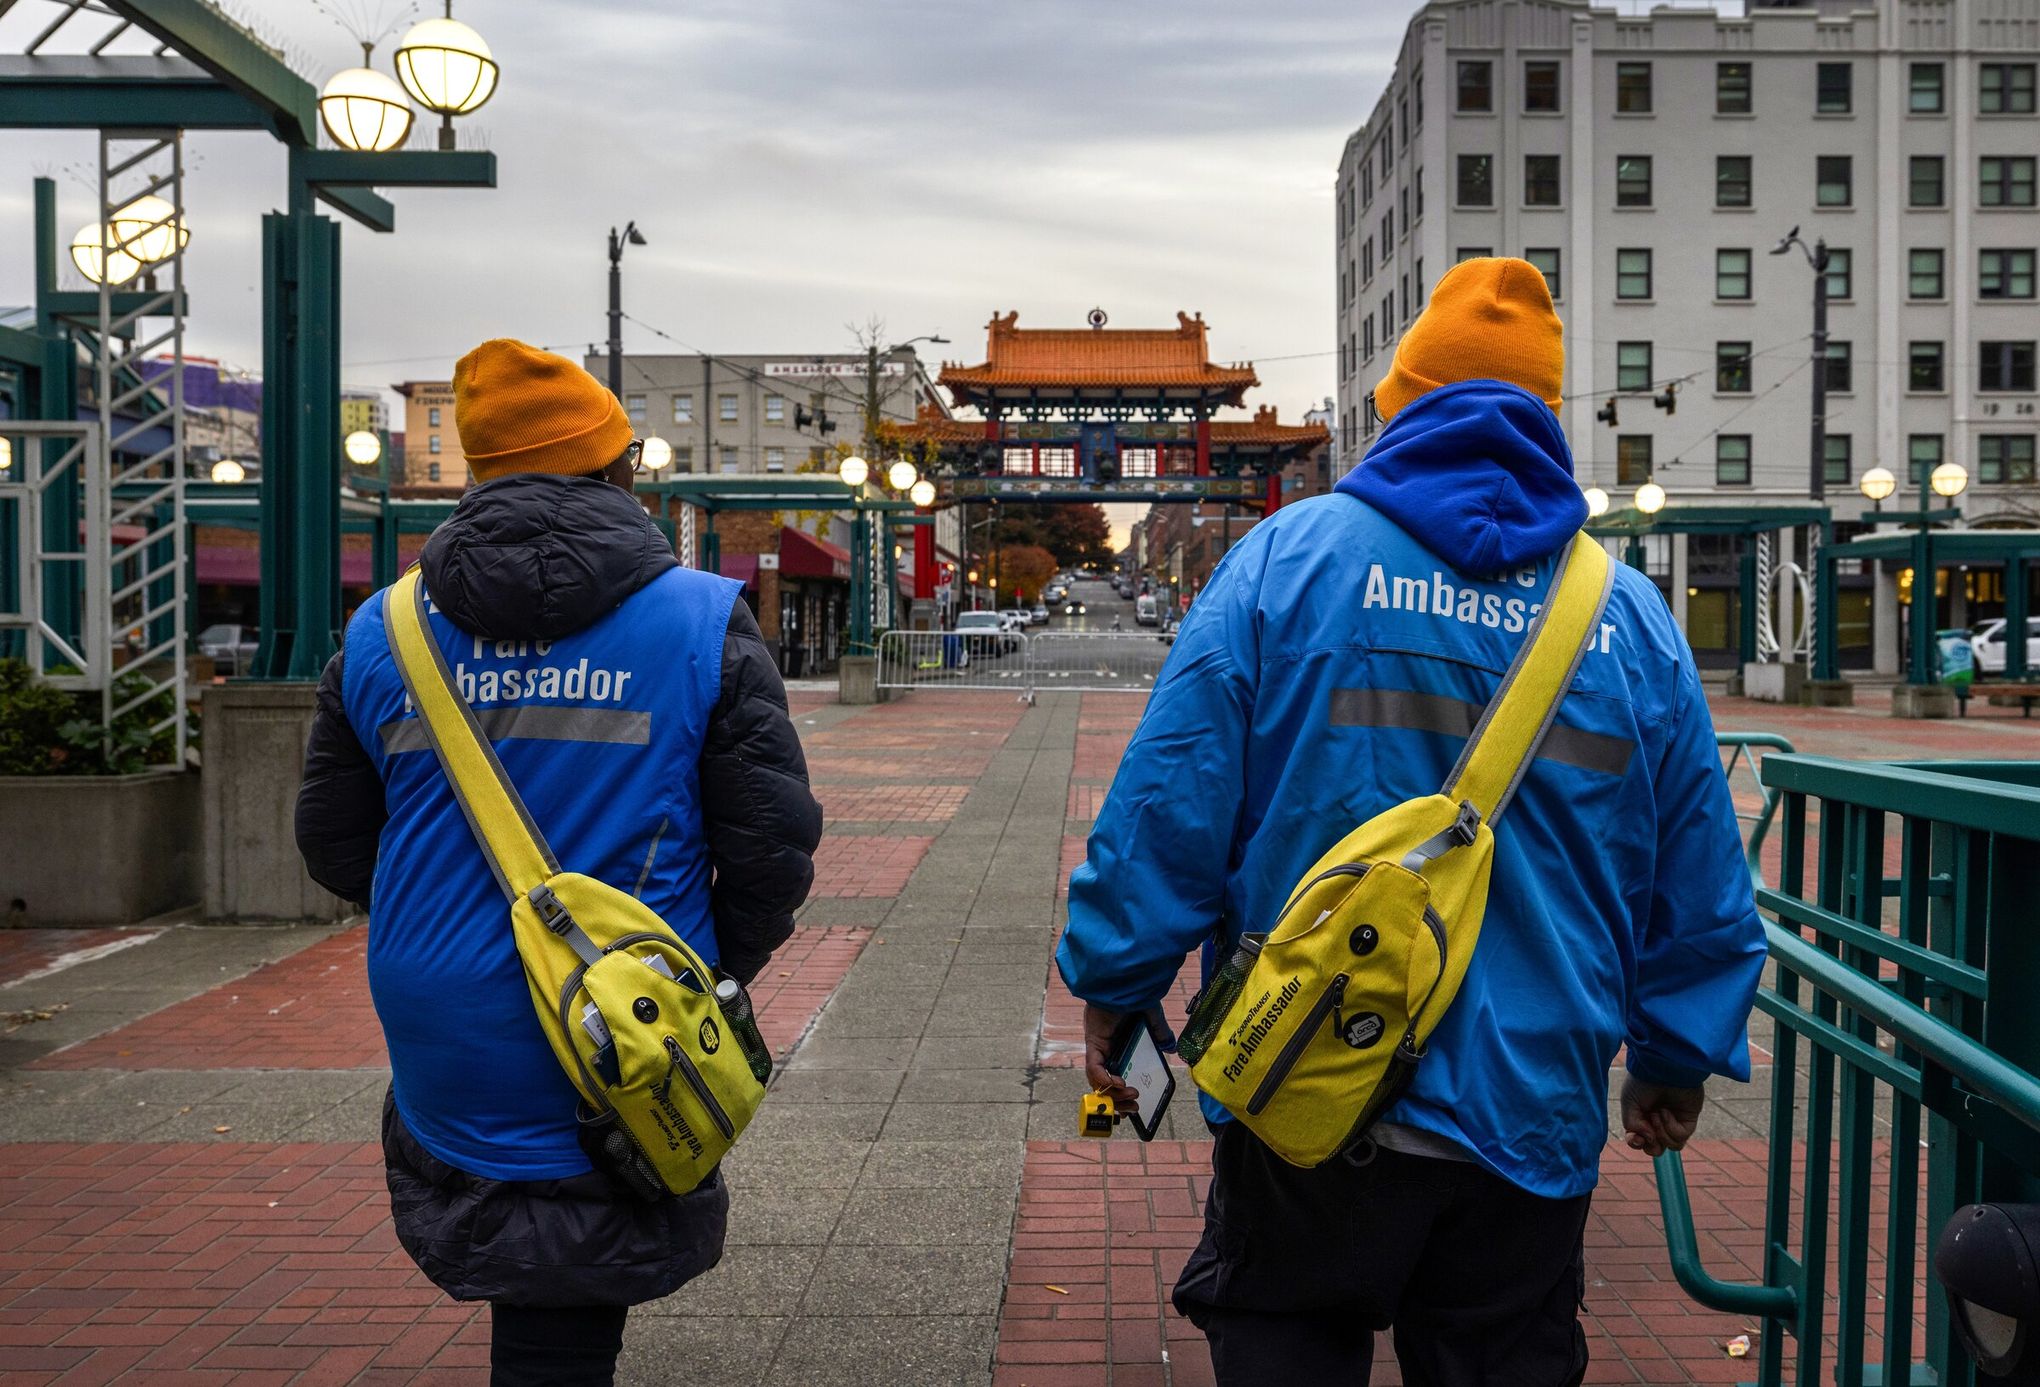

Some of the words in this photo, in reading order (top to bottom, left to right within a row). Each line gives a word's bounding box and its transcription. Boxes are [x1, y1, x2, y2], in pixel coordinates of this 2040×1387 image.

[404, 658, 632, 714] bassador
[1223, 1049, 1249, 1084] Fare
[1241, 975, 1303, 1057] Ambassador
[687, 1135, 703, 1161] Fare
